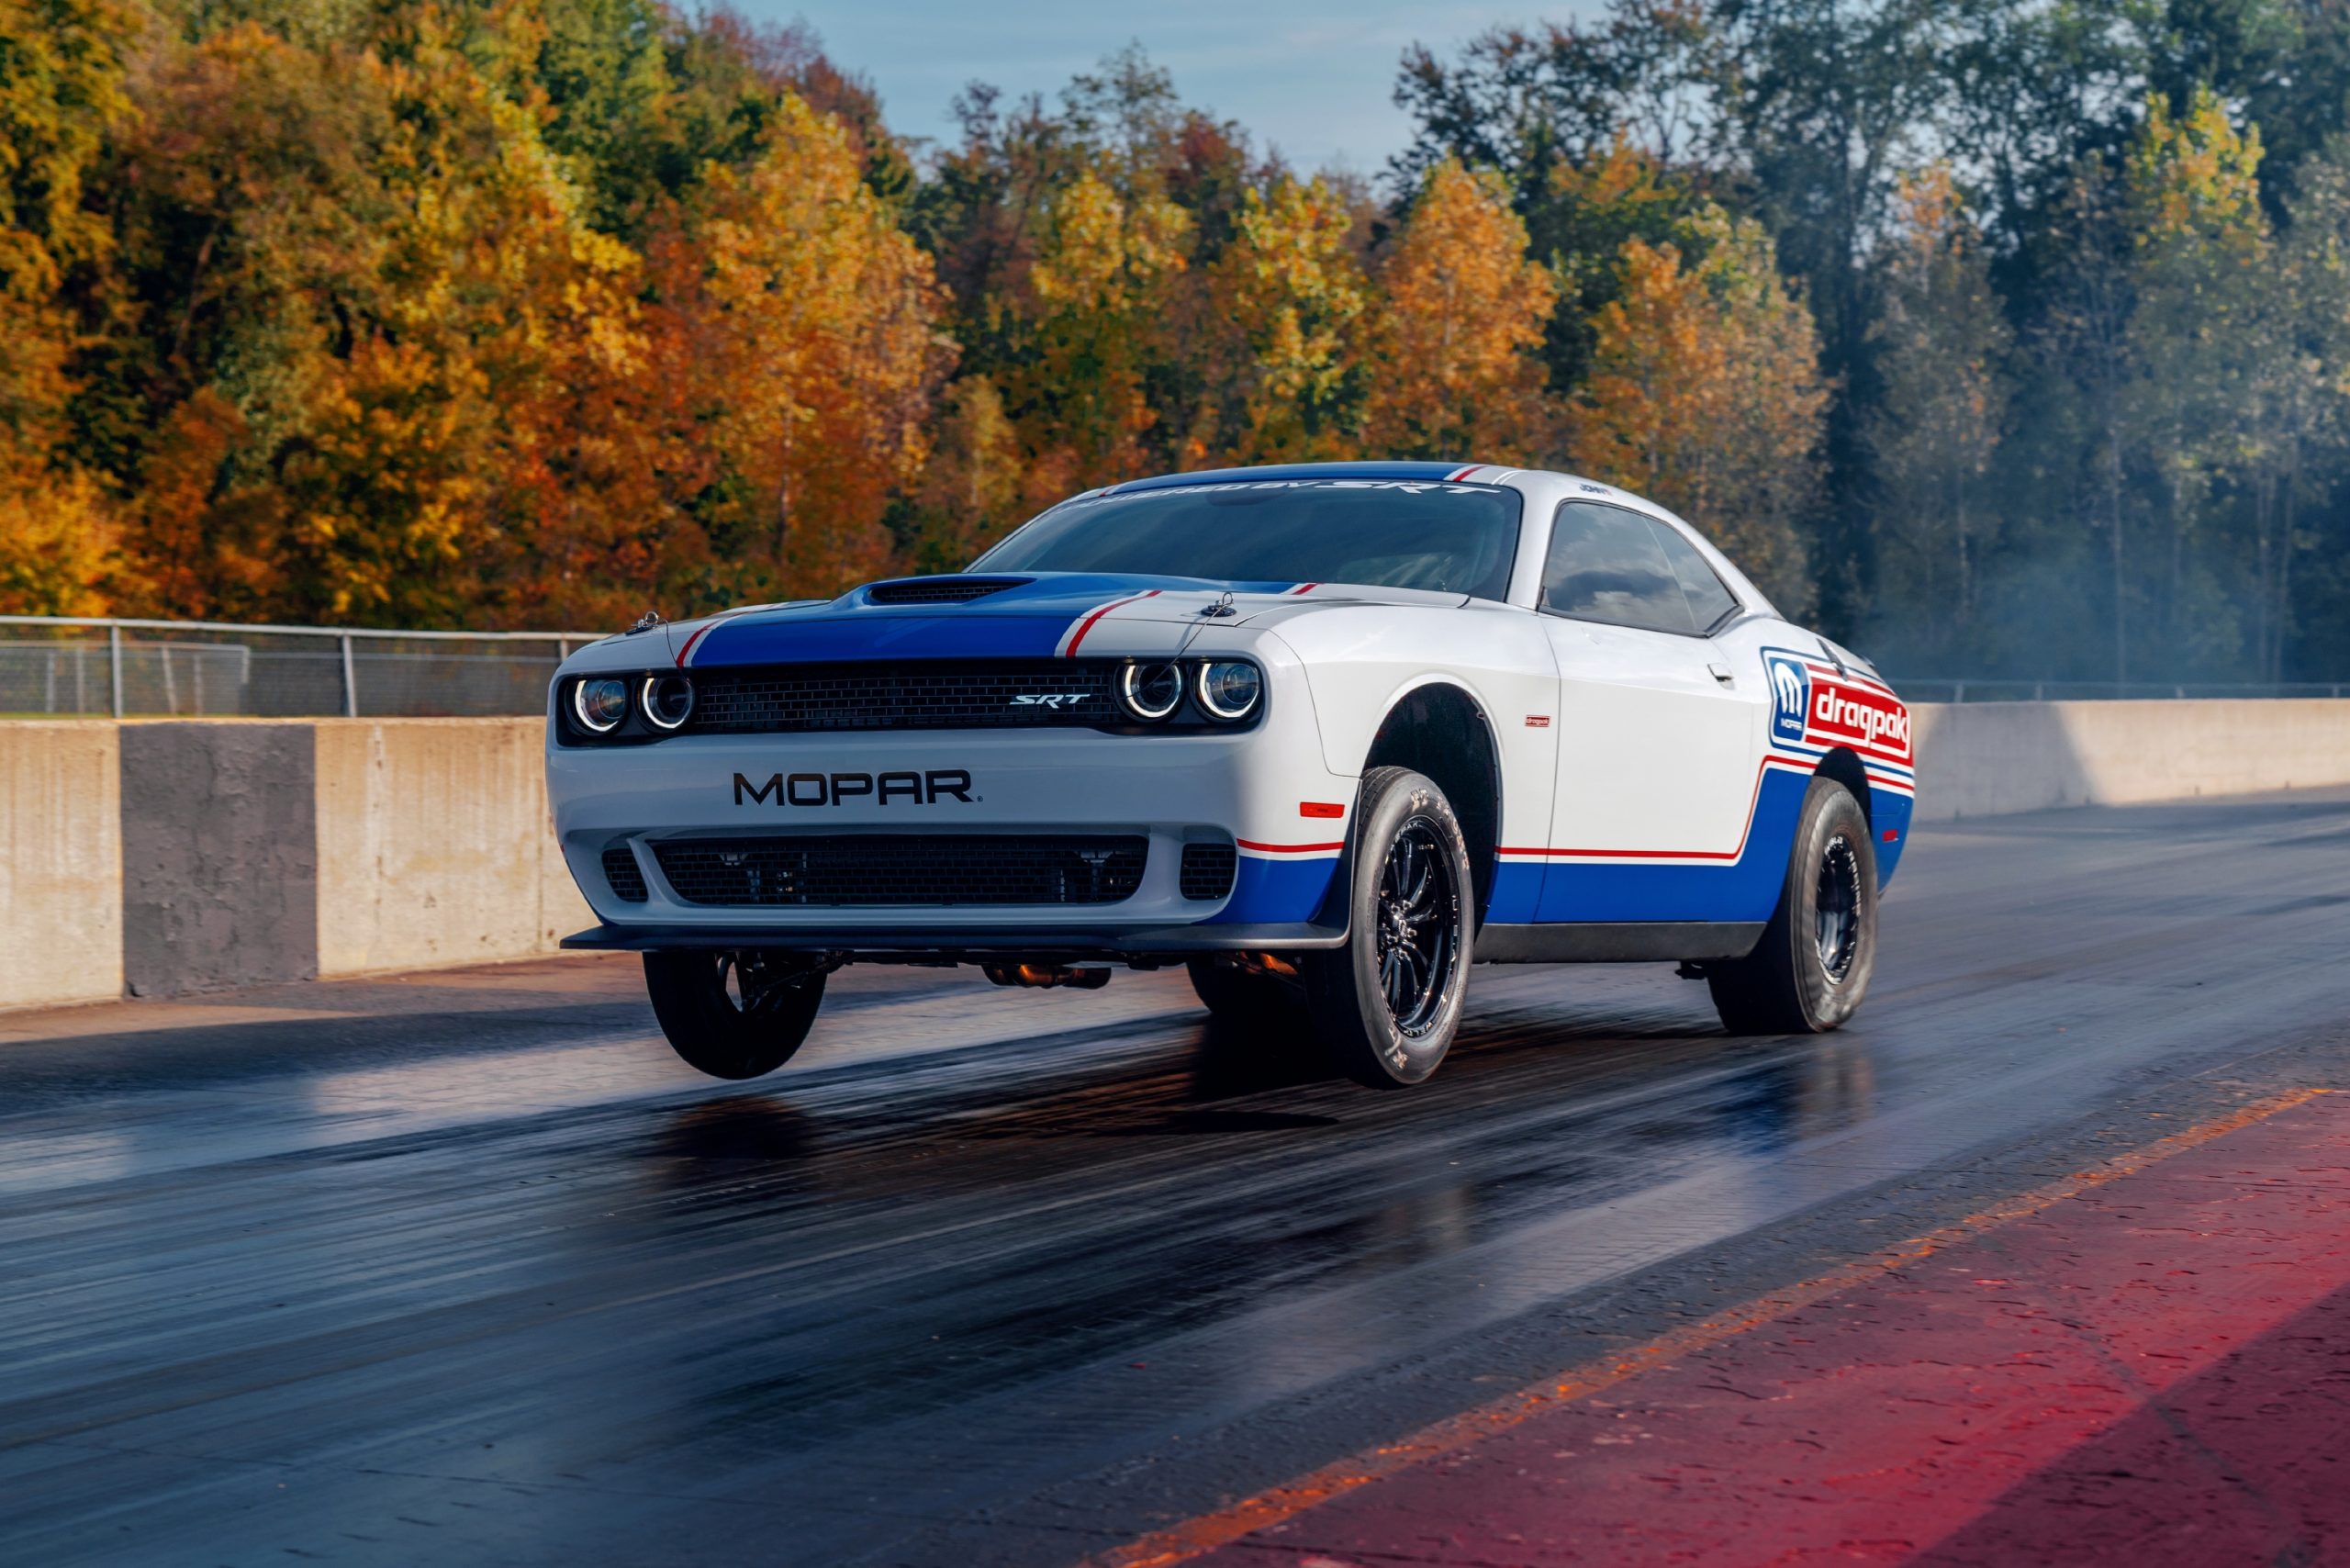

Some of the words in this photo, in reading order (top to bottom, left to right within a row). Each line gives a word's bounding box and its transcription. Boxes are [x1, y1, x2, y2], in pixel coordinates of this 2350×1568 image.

[1315, 481, 1501, 494] SRT
[1009, 693, 1091, 710] SRT
[1816, 687, 1907, 748] dragpak
[733, 769, 975, 806] MOPAR
